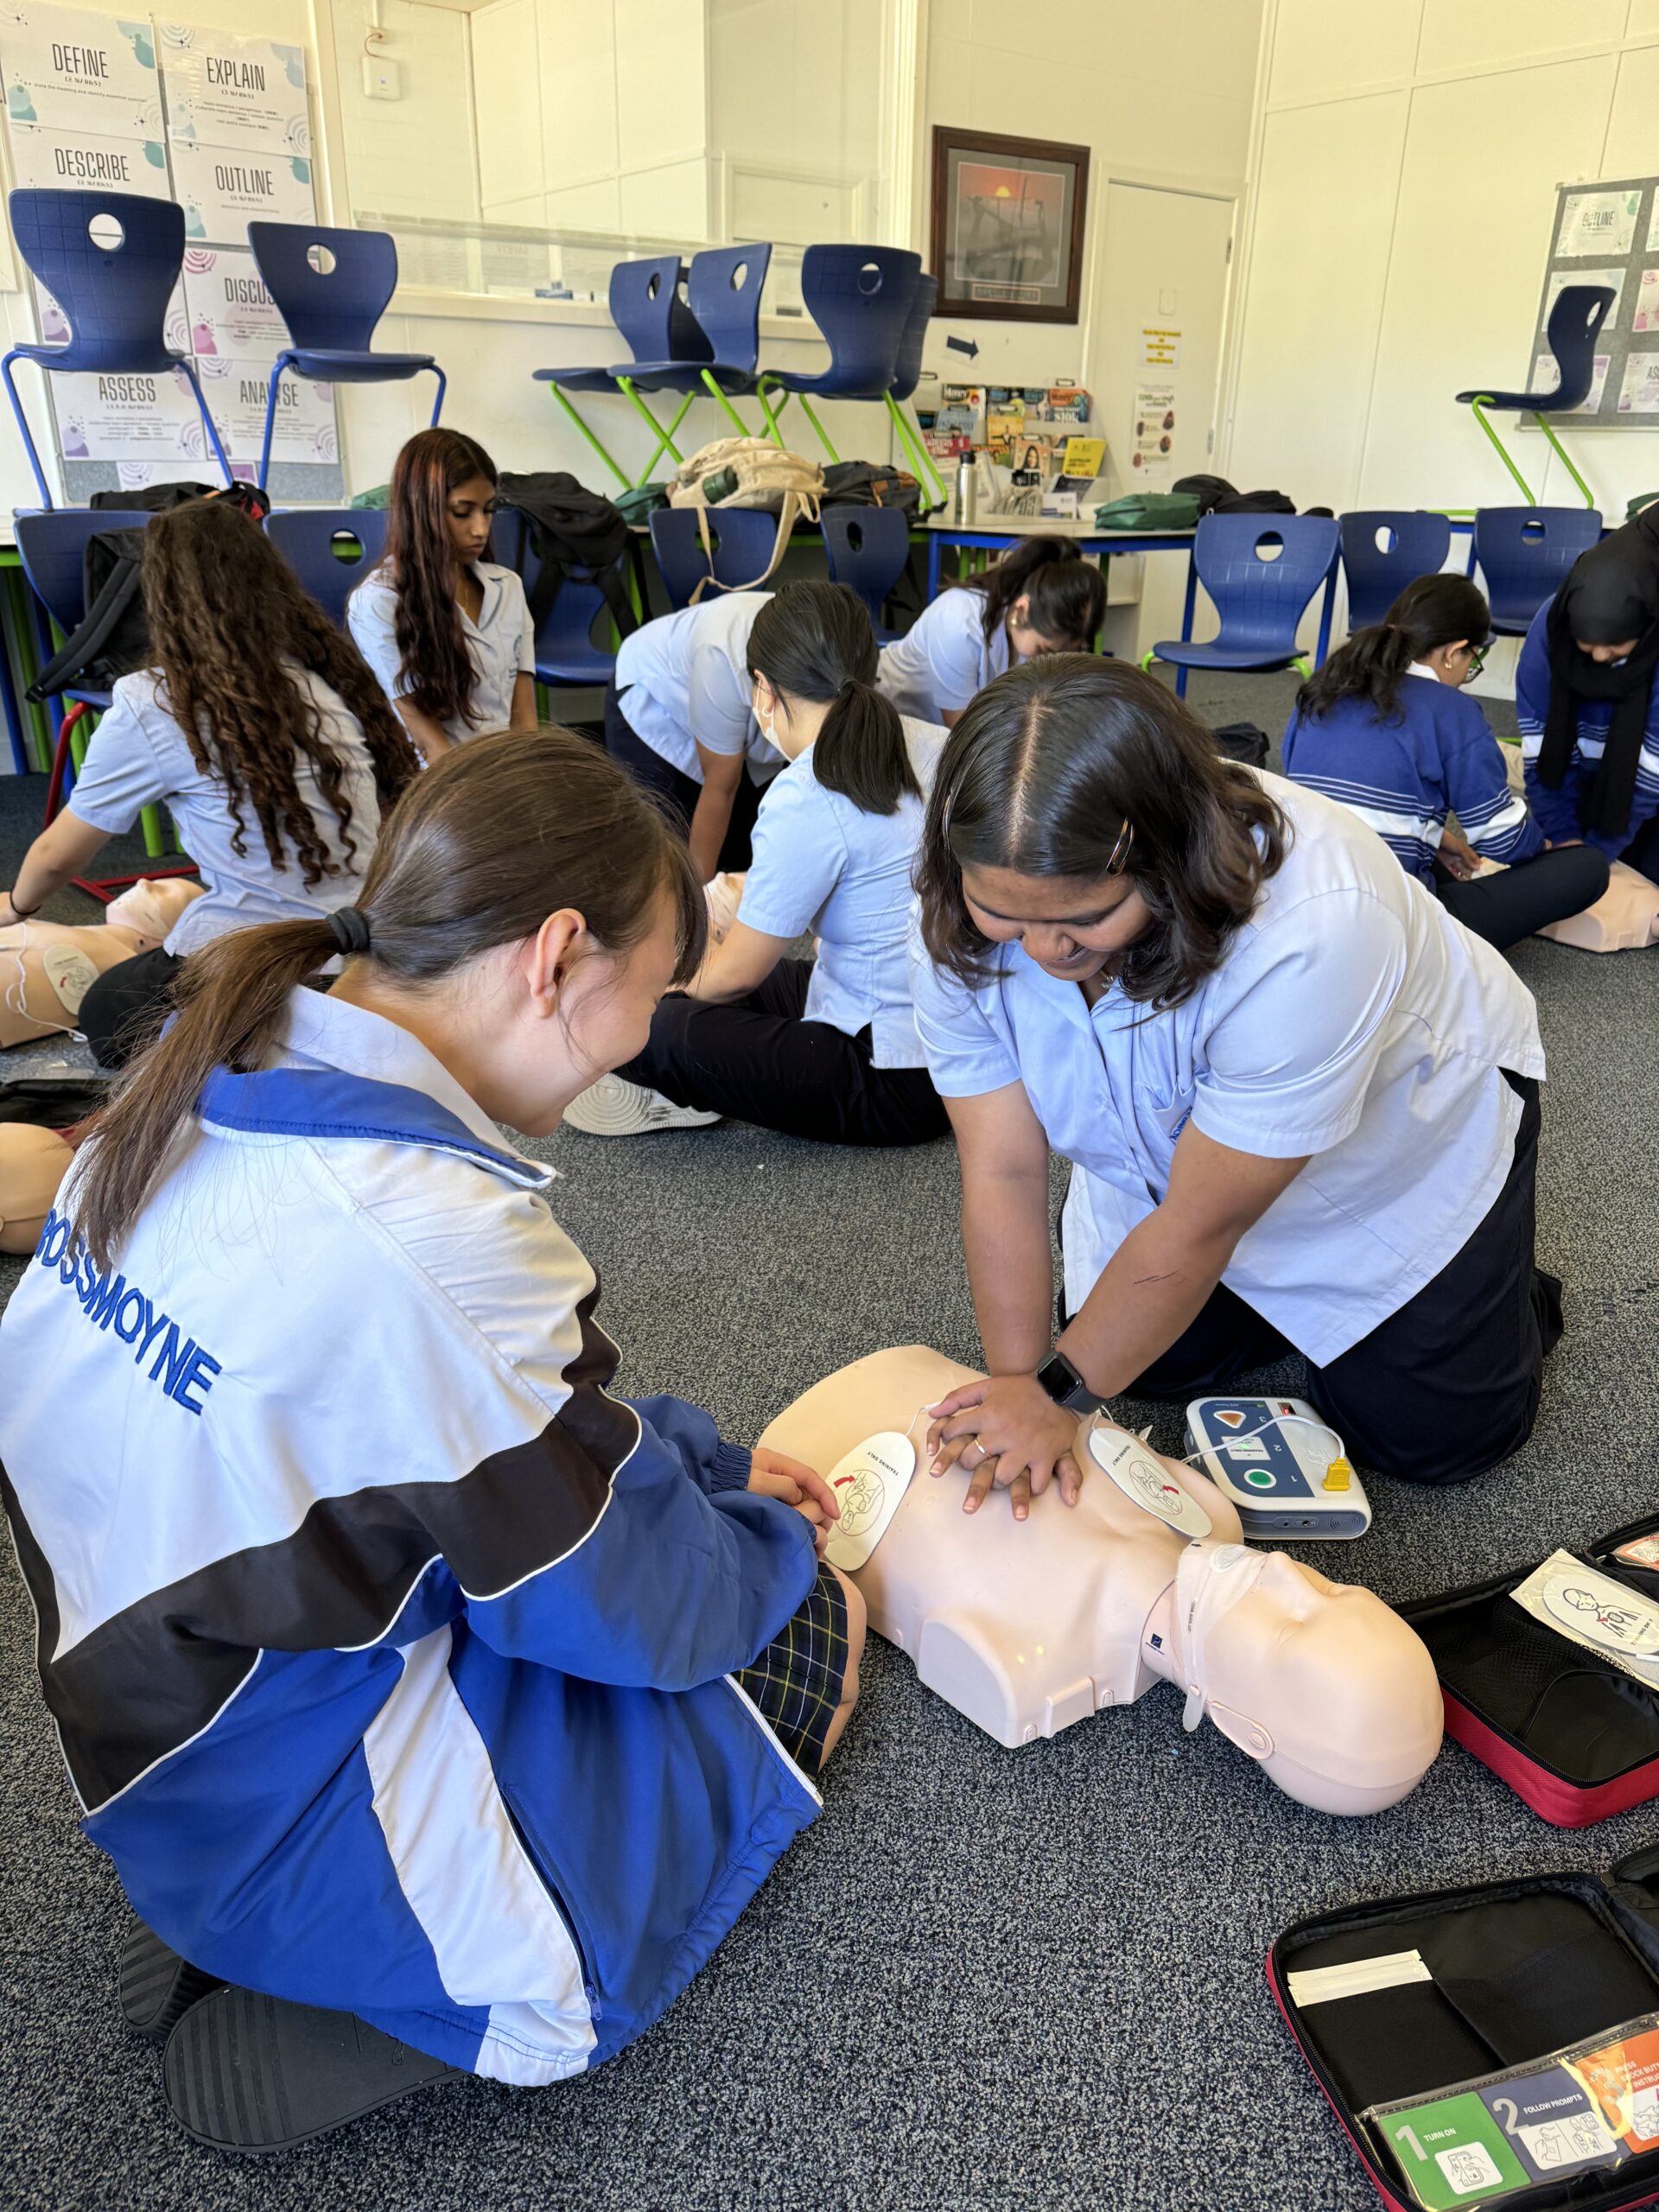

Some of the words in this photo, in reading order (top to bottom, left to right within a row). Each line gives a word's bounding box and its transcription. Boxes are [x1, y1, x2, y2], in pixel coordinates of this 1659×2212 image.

[52, 43, 109, 79] DEFINE
[207, 57, 265, 92] EXPLAIN
[54, 148, 130, 181] DESCRIBE
[215, 165, 275, 195] OUTLINE
[99, 376, 156, 403] ASSESS
[867, 1452, 879, 1461] ONLY
[879, 1459, 899, 1476] TRAINING
[1291, 1474, 1298, 1483] 1
[1615, 2061, 1637, 2074] PRESS
[1492, 2098, 1529, 2135] 2
[1523, 2101, 1552, 2114] FOLLOW
[1551, 2093, 1583, 2108] PROMPTS
[1395, 2125, 1428, 2161] 1
[1423, 2130, 1445, 2142] TURN
[1445, 2127, 1457, 2136] ON
